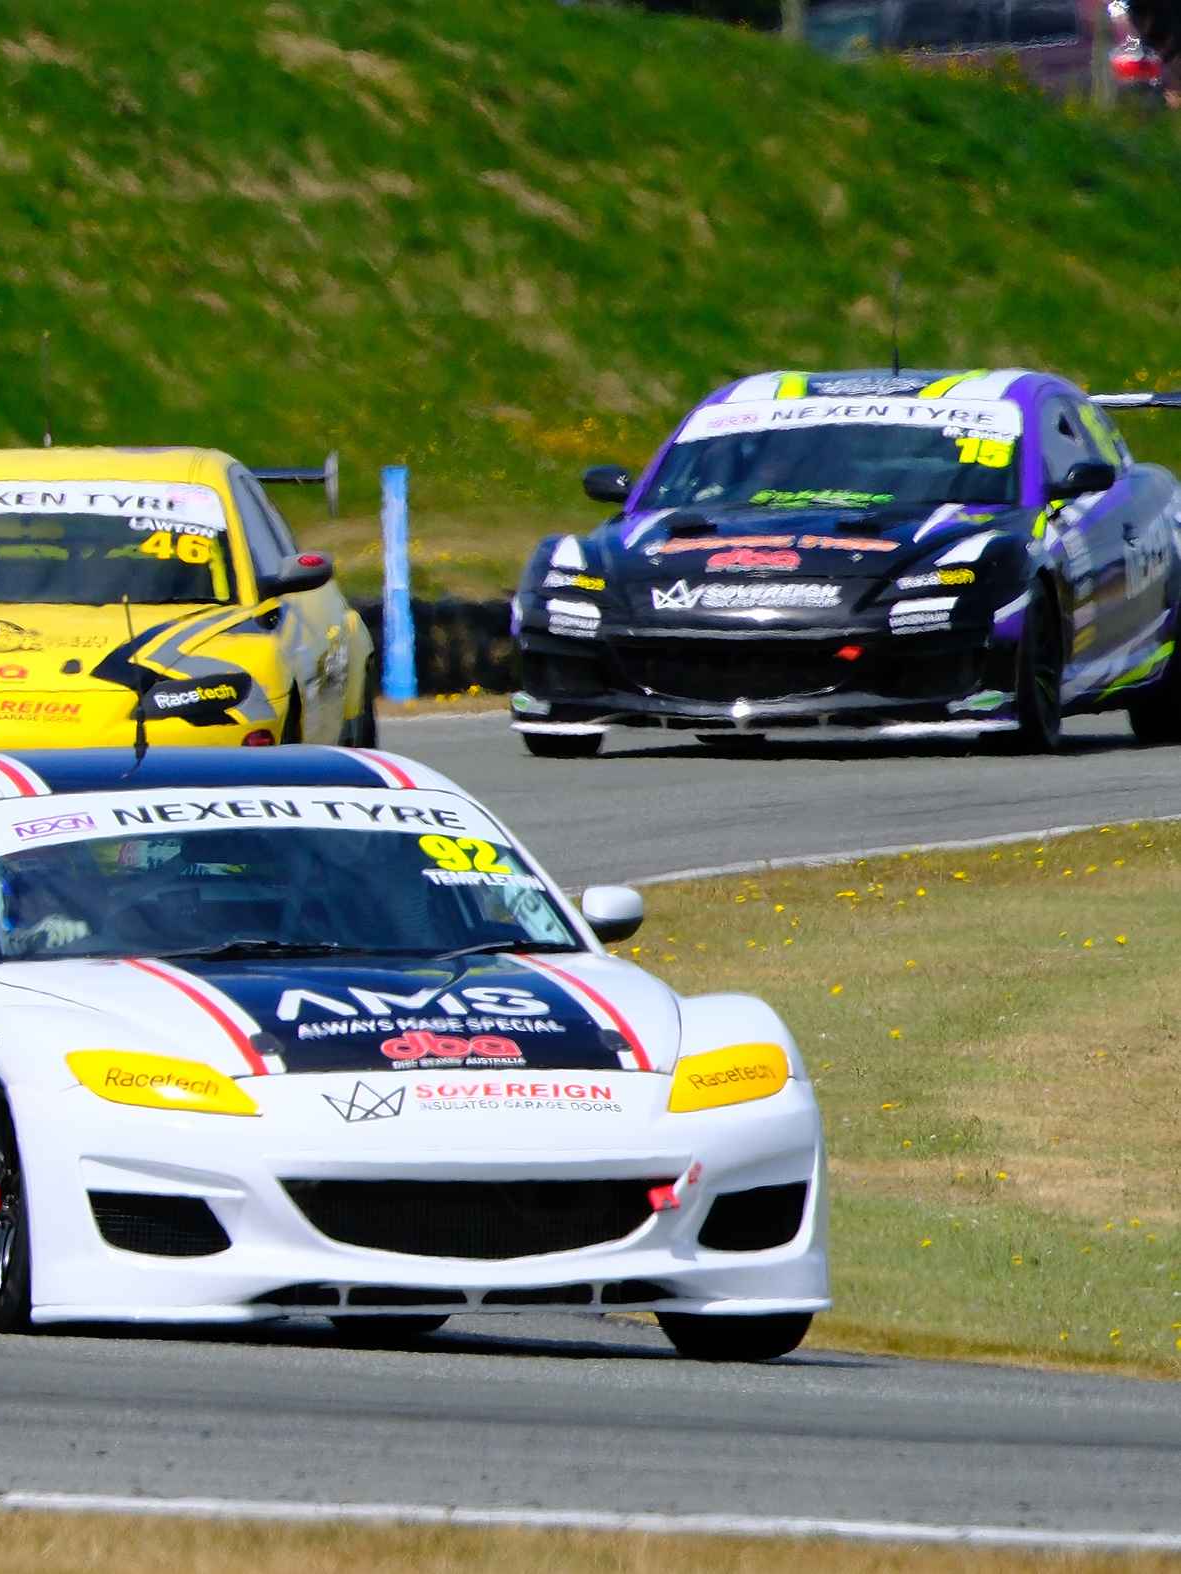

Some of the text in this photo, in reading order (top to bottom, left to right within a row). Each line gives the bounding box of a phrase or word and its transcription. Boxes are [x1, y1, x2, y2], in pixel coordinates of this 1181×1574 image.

[771, 404, 995, 424] NEXEN TYRE
[955, 437, 1015, 469] 15
[84, 494, 177, 512] TYRE
[140, 530, 213, 565] 46
[153, 684, 238, 710] Racetech
[13, 813, 96, 840] NEXEN
[111, 799, 467, 830] NEXEN TYRE
[418, 834, 513, 875] 92
[298, 1016, 567, 1041] ALWAYS MADE SPECIAL
[380, 1030, 523, 1060] dba
[465, 1055, 527, 1067] AUSTRALIA
[104, 1066, 220, 1097] Racetech
[687, 1063, 777, 1091] Racetech
[415, 1082, 613, 1101] SOVEREIGN
[569, 1101, 623, 1113] DOORS
